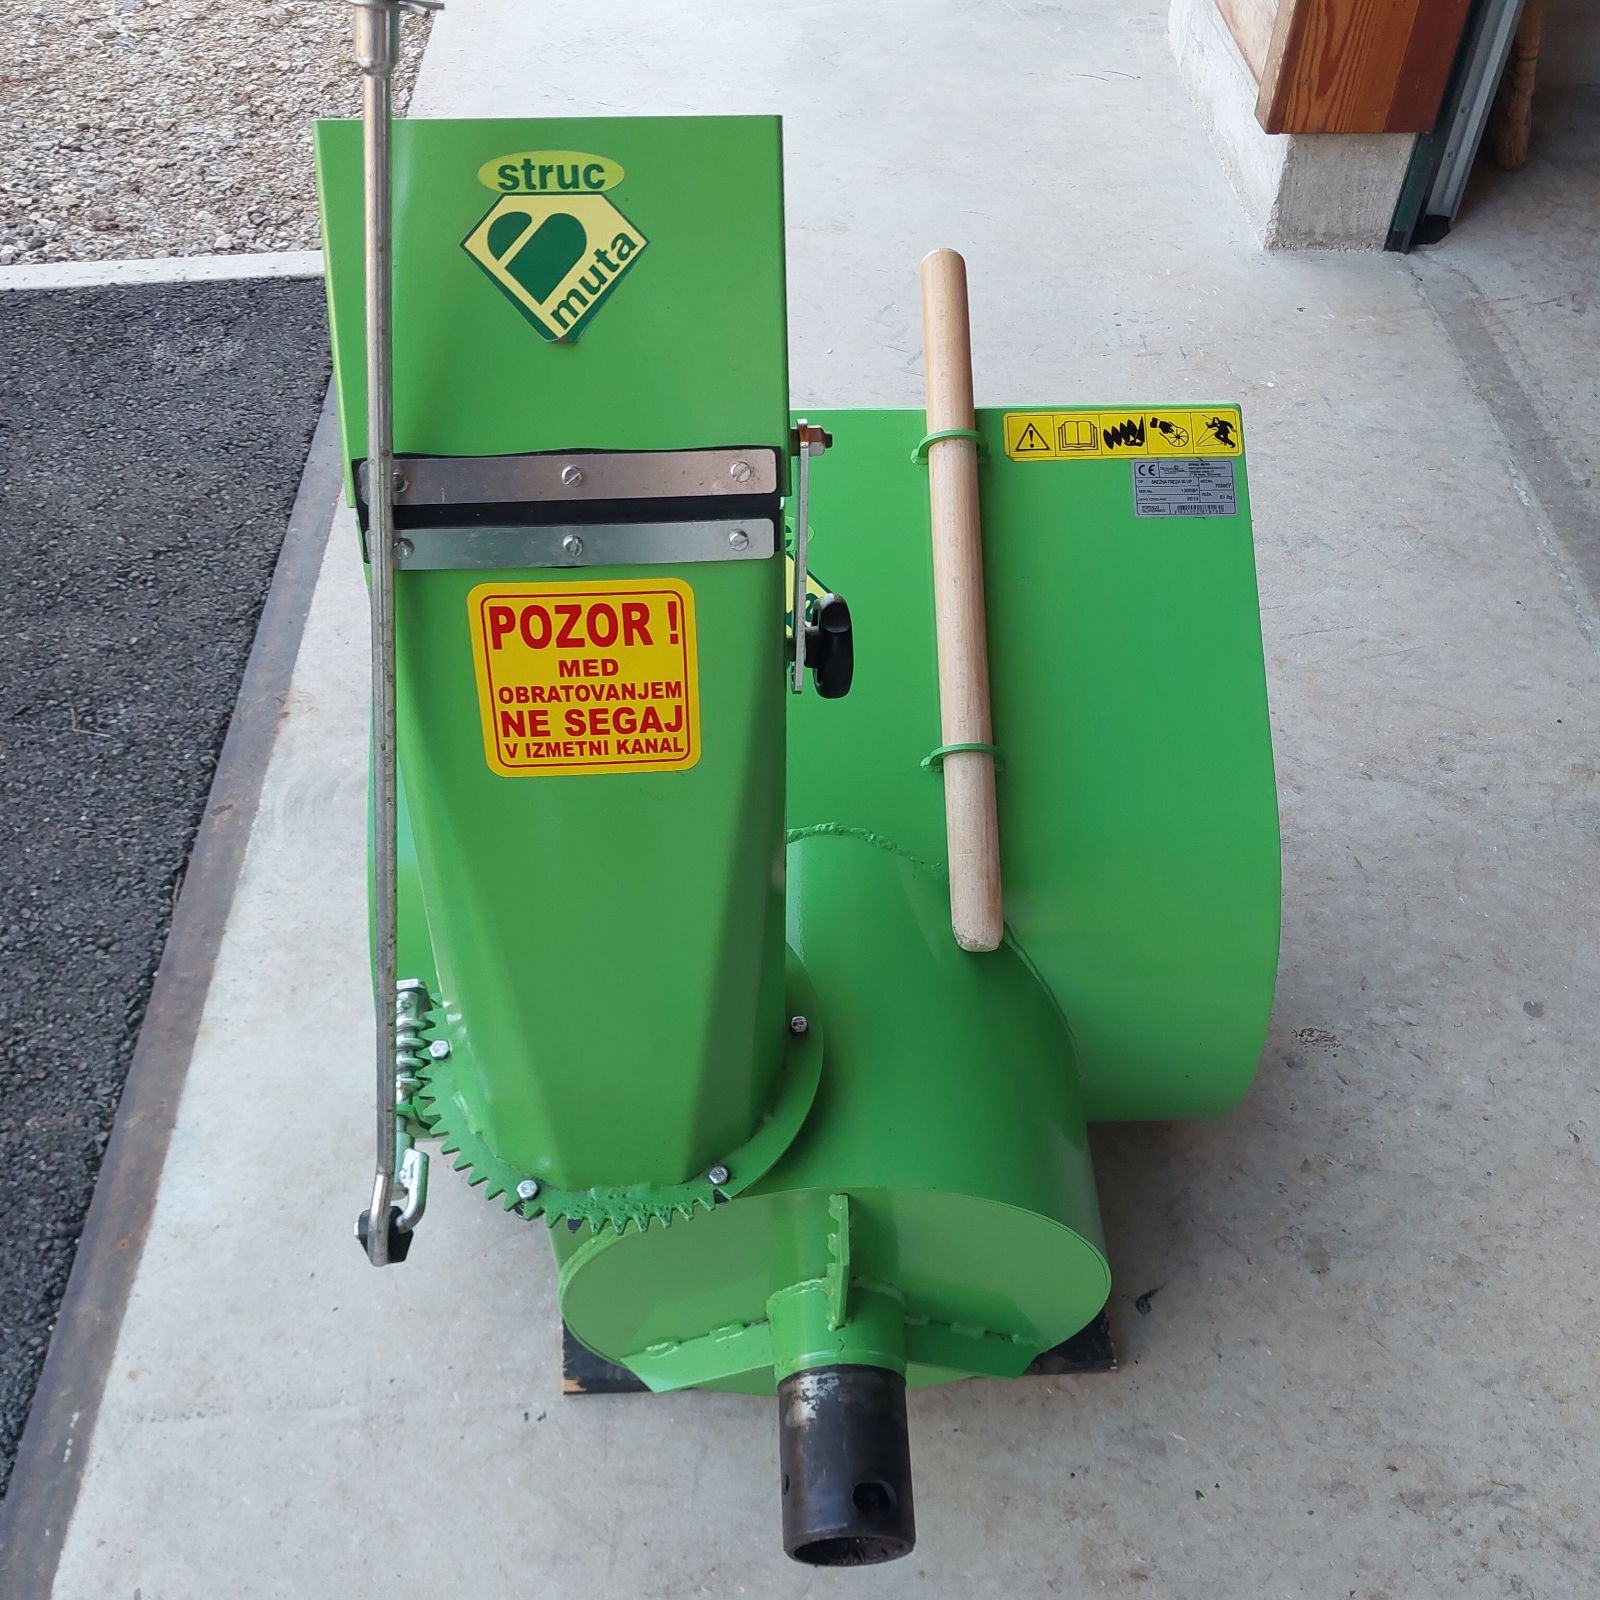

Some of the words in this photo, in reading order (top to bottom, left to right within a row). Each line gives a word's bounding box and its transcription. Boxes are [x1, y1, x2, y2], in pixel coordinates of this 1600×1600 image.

[497, 158, 605, 190] struc
[550, 232, 638, 330] muta
[489, 602, 654, 650] POZOR
[667, 600, 679, 645] !
[558, 658, 619, 678] MED
[498, 681, 682, 704] OBRATOVANJEM
[500, 709, 551, 738] NE
[564, 705, 683, 737] SEGAJ
[504, 743, 519, 758] V
[526, 740, 609, 758] IZMETNI
[616, 737, 684, 755] KANAL
